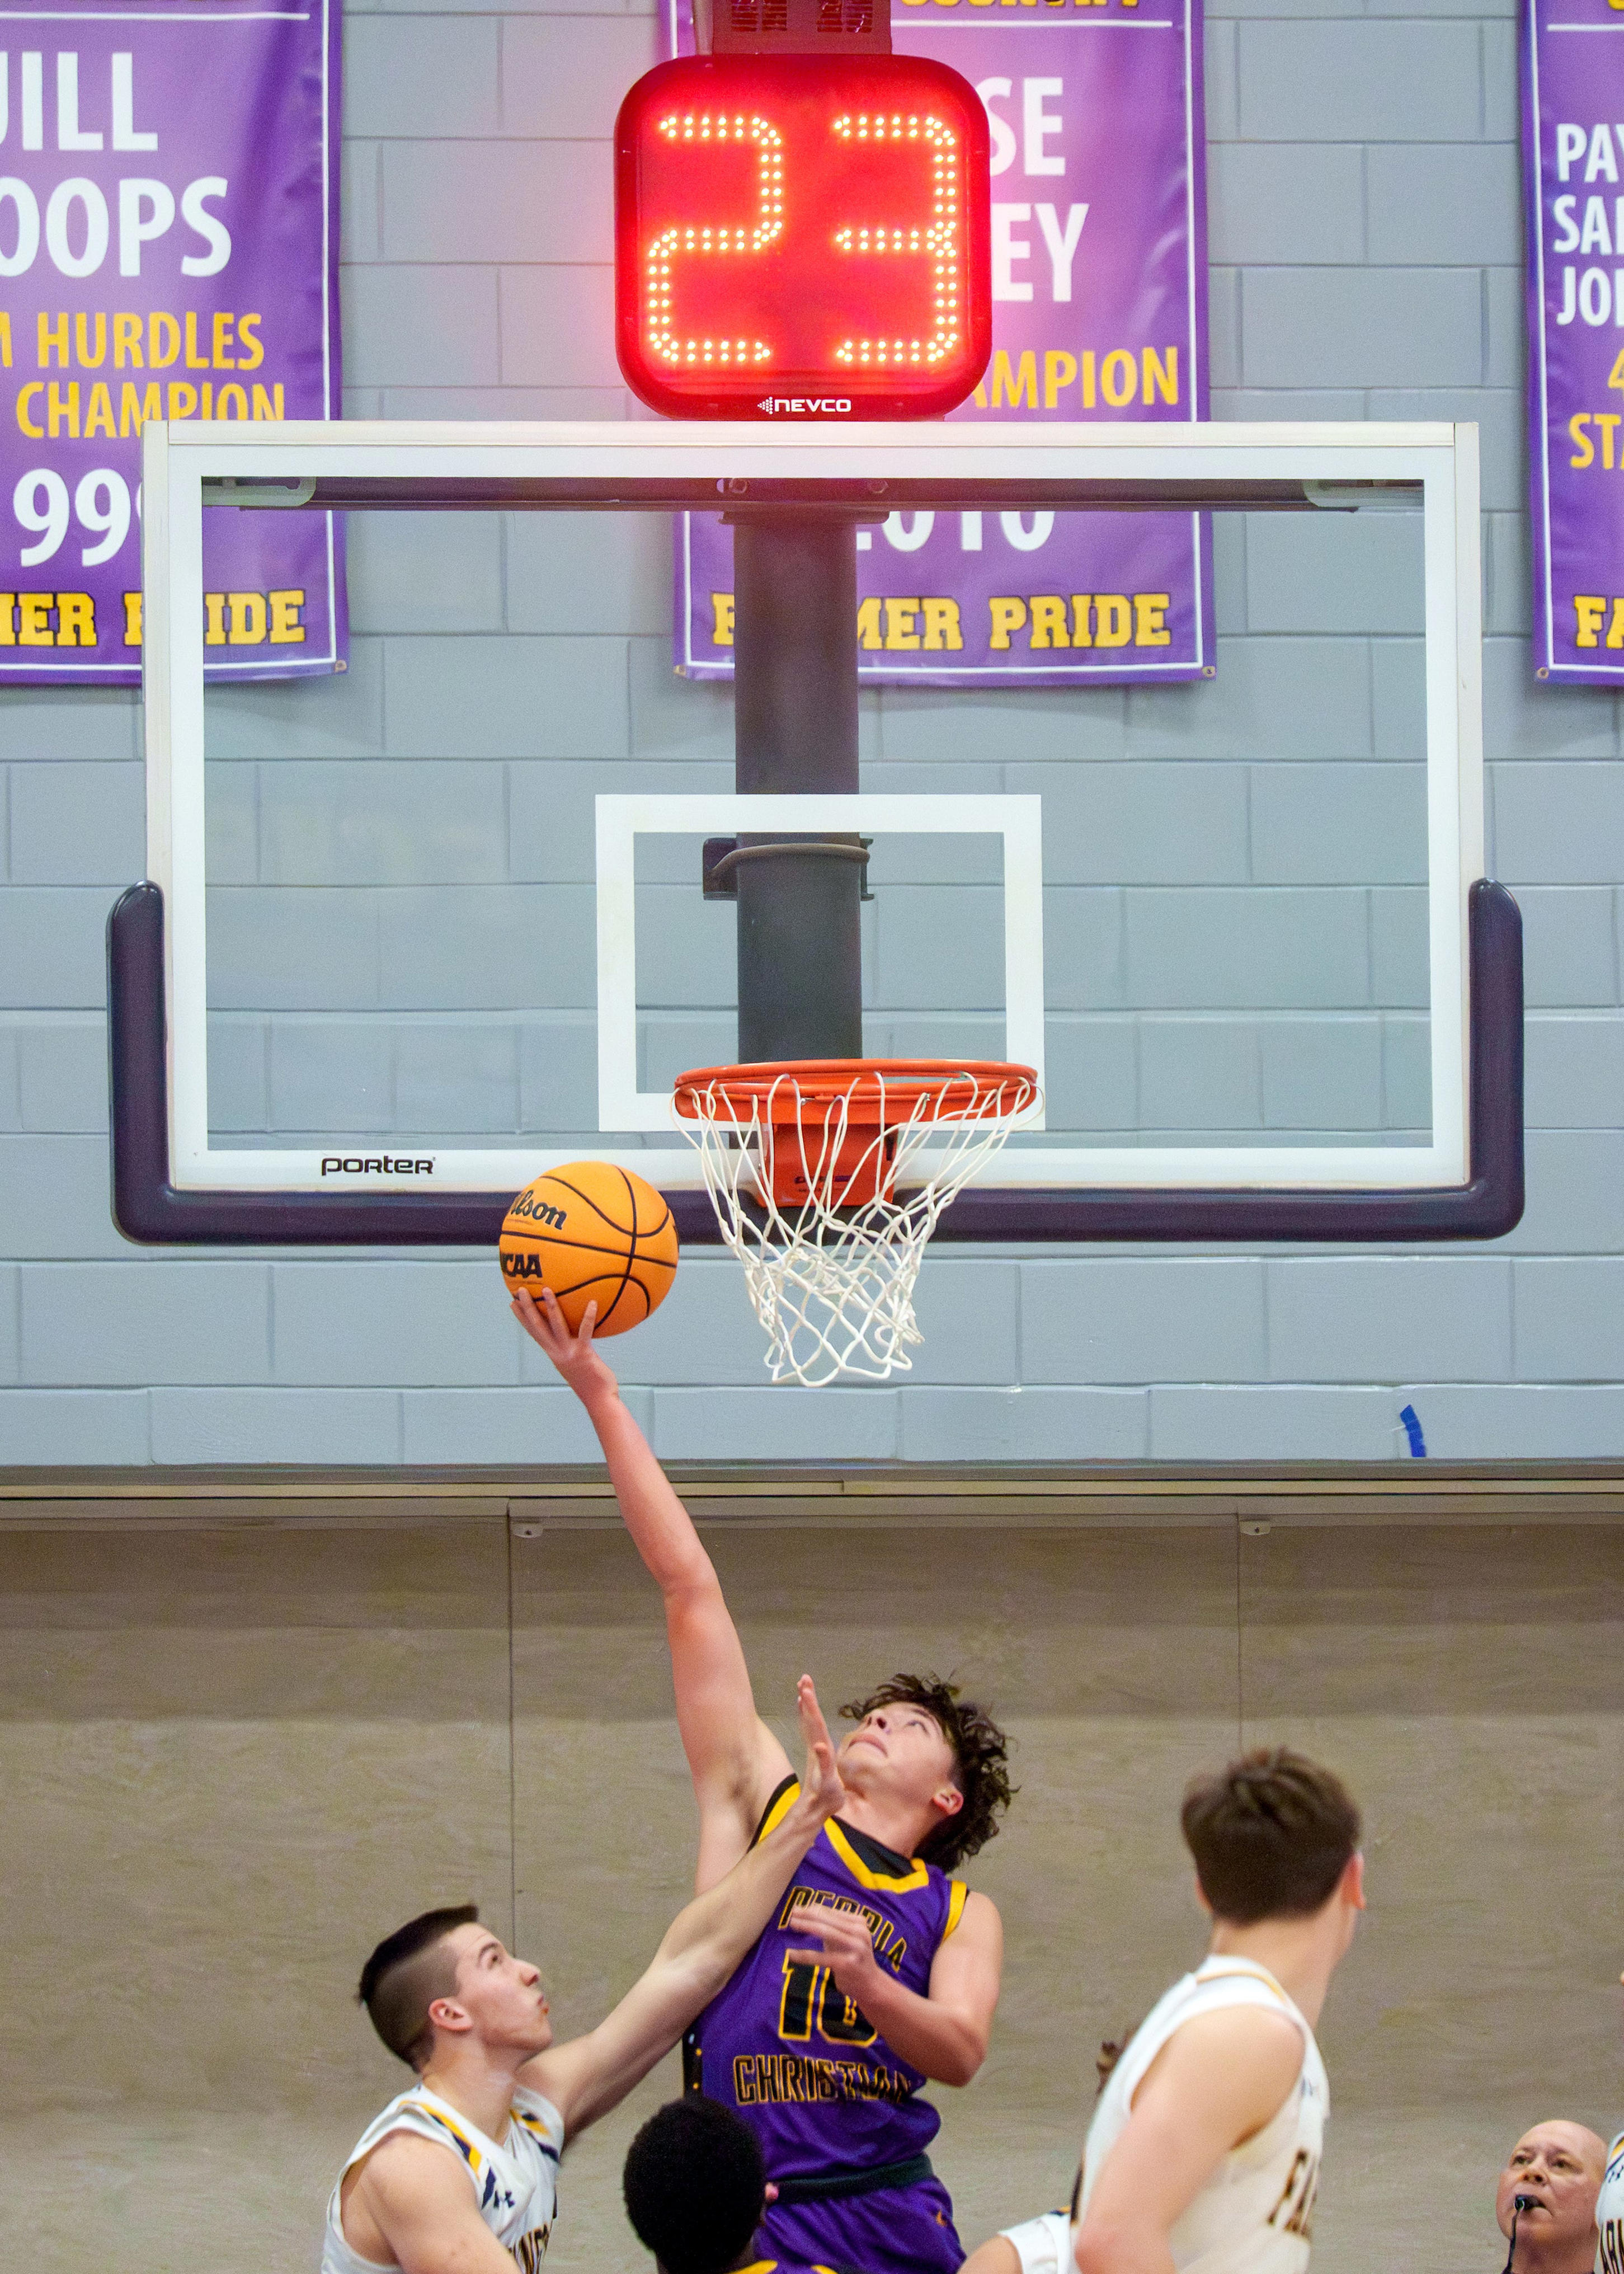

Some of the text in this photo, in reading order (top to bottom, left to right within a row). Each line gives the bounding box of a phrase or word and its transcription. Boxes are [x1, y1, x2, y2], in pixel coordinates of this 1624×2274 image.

[0, 51, 158, 151] ILL
[1557, 123, 1624, 182] PA
[648, 116, 957, 363] 23
[1553, 194, 1624, 256] SA
[1556, 265, 1624, 327] JO
[37, 311, 265, 370] HURDLES
[774, 398, 852, 413] NEVCO
[971, 346, 1180, 410] MPION
[15, 381, 285, 439] CHAMPION
[1568, 412, 1624, 469] ST
[12, 468, 143, 567] 99
[988, 592, 1172, 651] PRIDE
[509, 1189, 568, 1230] lson
[500, 1253, 543, 1278] CAA
